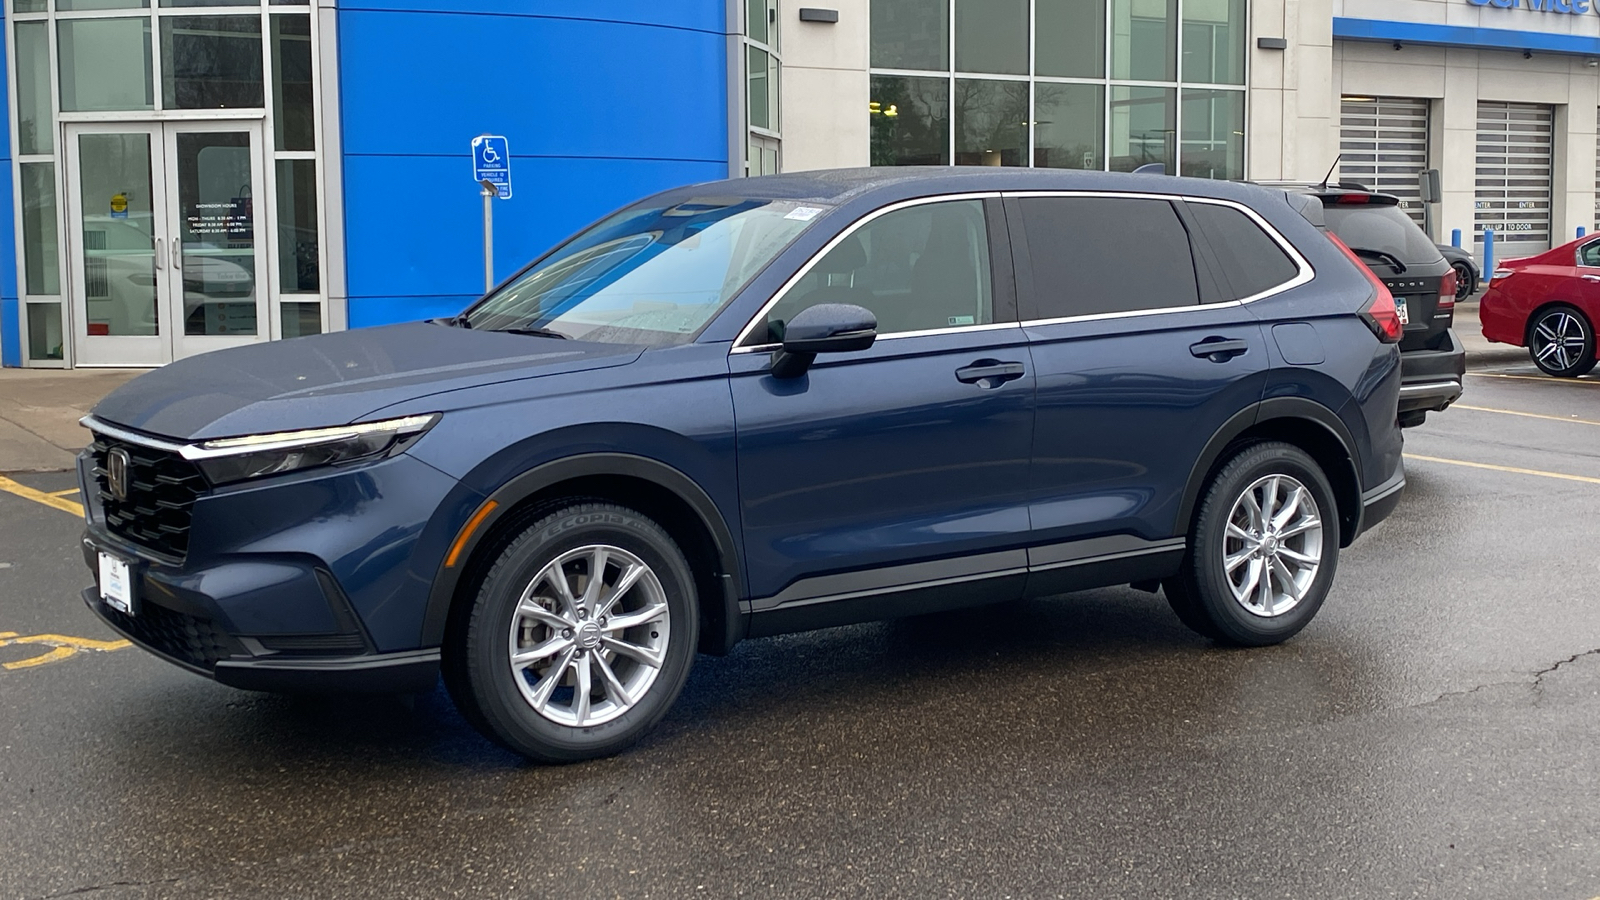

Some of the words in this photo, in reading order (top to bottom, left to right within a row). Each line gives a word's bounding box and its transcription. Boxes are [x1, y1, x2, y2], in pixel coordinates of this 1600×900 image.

[1475, 201, 1491, 209] ENTER
[1519, 201, 1535, 209] ENTER
[1481, 223, 1495, 231] PULL
[1495, 223, 1503, 231] UP
[1387, 280, 1424, 288] ODGE
